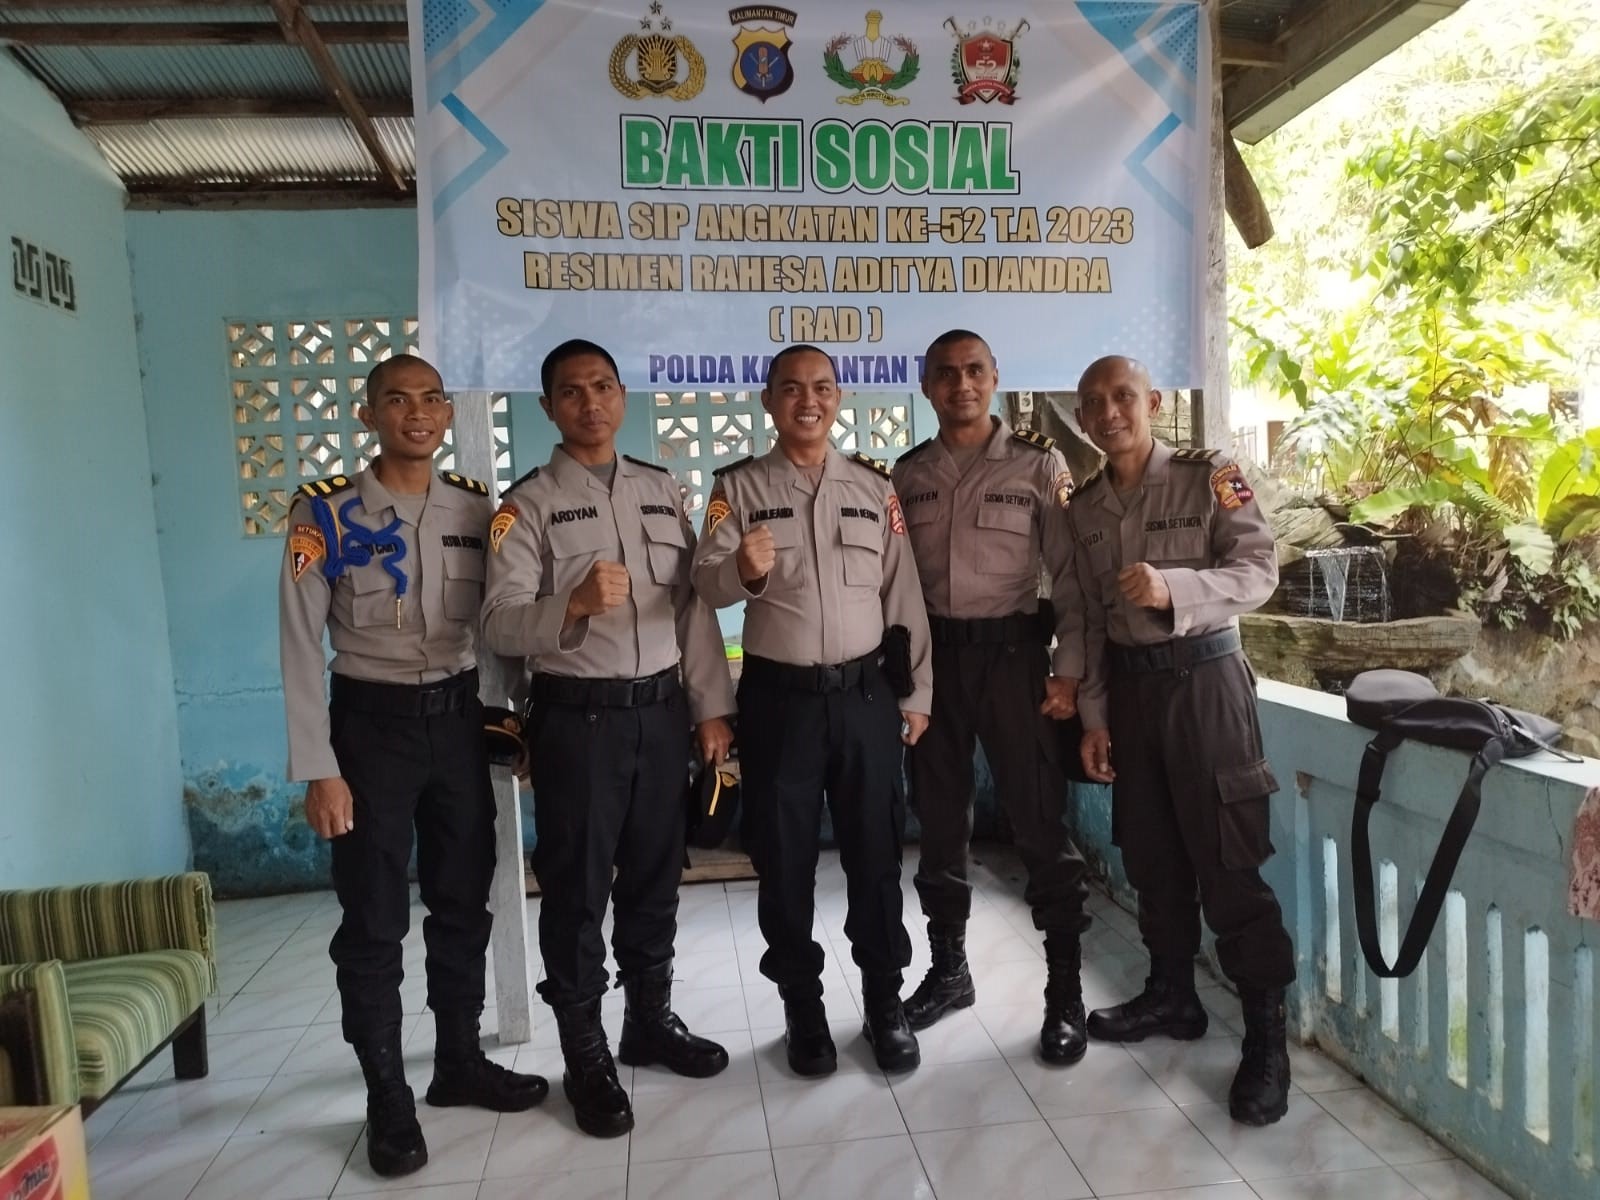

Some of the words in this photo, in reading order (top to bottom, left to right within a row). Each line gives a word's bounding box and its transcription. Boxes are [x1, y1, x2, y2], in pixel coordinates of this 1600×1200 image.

[731, 8, 773, 22] KALIMANTAN
[775, 10, 795, 25] TIMUR
[975, 60, 997, 74] 52
[620, 114, 804, 192] BAKTI
[810, 118, 1020, 195] SOSIAL
[496, 197, 623, 239] SISWA
[627, 201, 690, 241] SIP
[695, 203, 878, 243] ANGKATAN
[885, 206, 985, 243] KE-52
[991, 206, 1041, 243] T.A
[1046, 206, 1134, 244] 2023
[523, 250, 683, 291] RESIMEN
[690, 255, 829, 293] RAHESA
[832, 256, 957, 293] ADITYA
[962, 256, 1113, 293] DIANDRA
[649, 355, 735, 384] POLDA
[550, 506, 598, 525] ARDYAN
